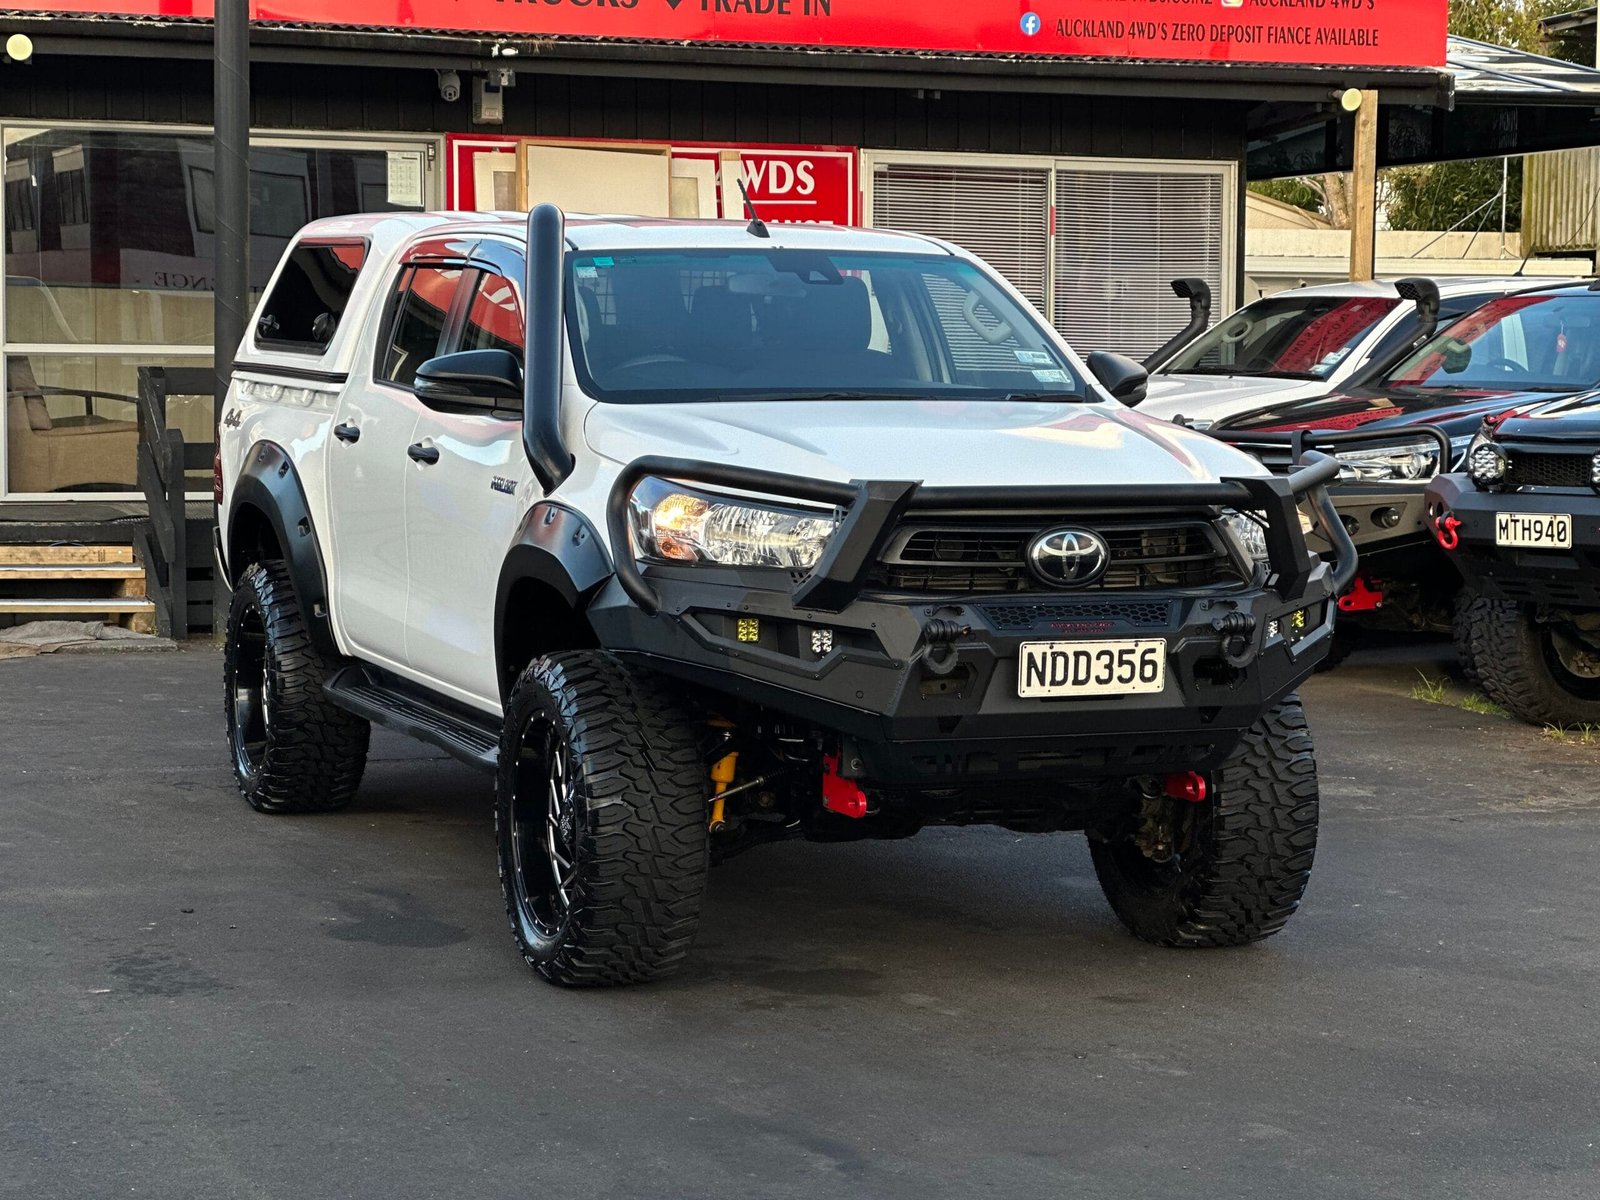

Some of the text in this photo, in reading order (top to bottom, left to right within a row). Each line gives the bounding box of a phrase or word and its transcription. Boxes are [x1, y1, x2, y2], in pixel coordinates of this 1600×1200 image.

[1056, 19, 1379, 47] AUCKLAND 4WD'S ZERO DEPOSIT FIANCE AVAILABLE
[1498, 518, 1567, 542] MTH940
[1026, 647, 1158, 687] NDD356
